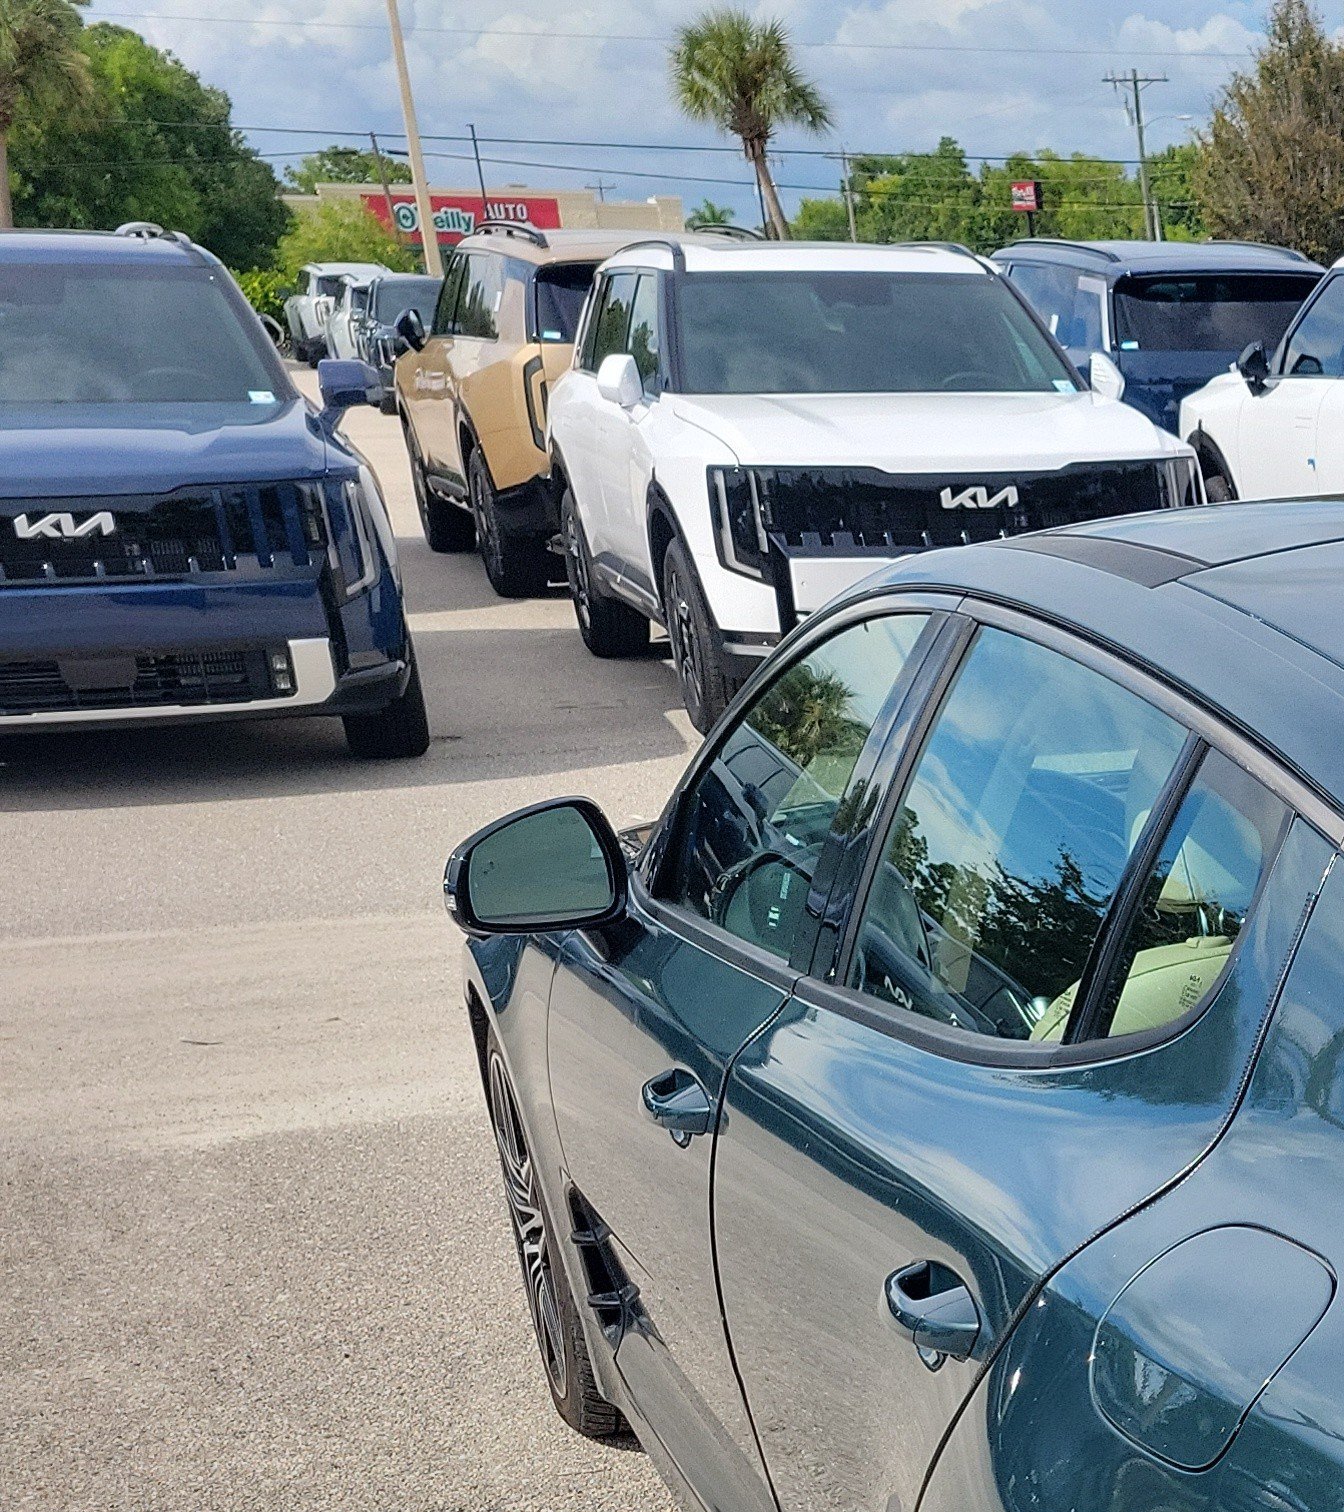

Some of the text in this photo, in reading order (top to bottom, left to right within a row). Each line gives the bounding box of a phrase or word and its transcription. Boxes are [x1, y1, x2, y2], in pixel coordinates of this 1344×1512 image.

[484, 203, 528, 220] AUTO
[940, 486, 1018, 508] KIA
[14, 512, 115, 538] KIA
